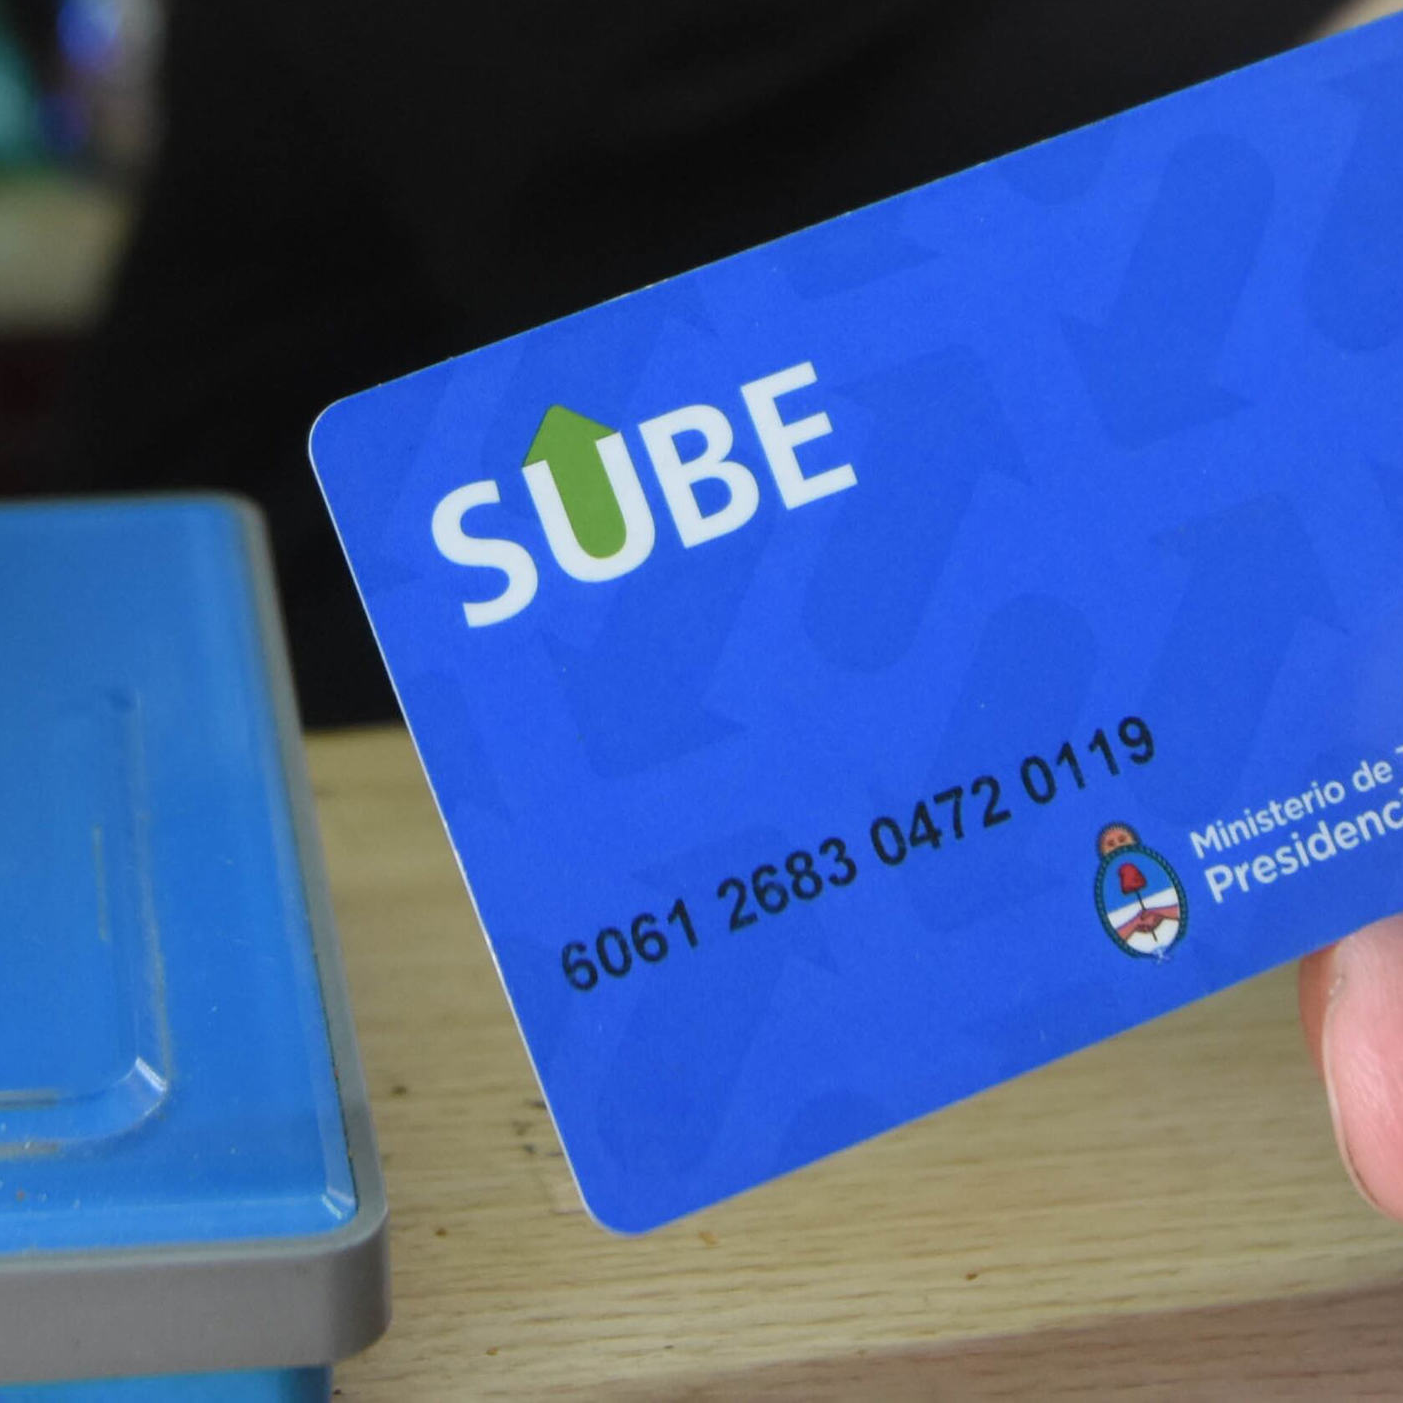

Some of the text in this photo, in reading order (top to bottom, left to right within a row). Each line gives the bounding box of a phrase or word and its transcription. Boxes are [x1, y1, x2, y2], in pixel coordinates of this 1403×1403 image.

[430, 361, 858, 627] SUBE
[562, 717, 1155, 991] 6061 2683 0472 0119
[1189, 780, 1346, 860] Ministerio
[1351, 760, 1394, 793] de
